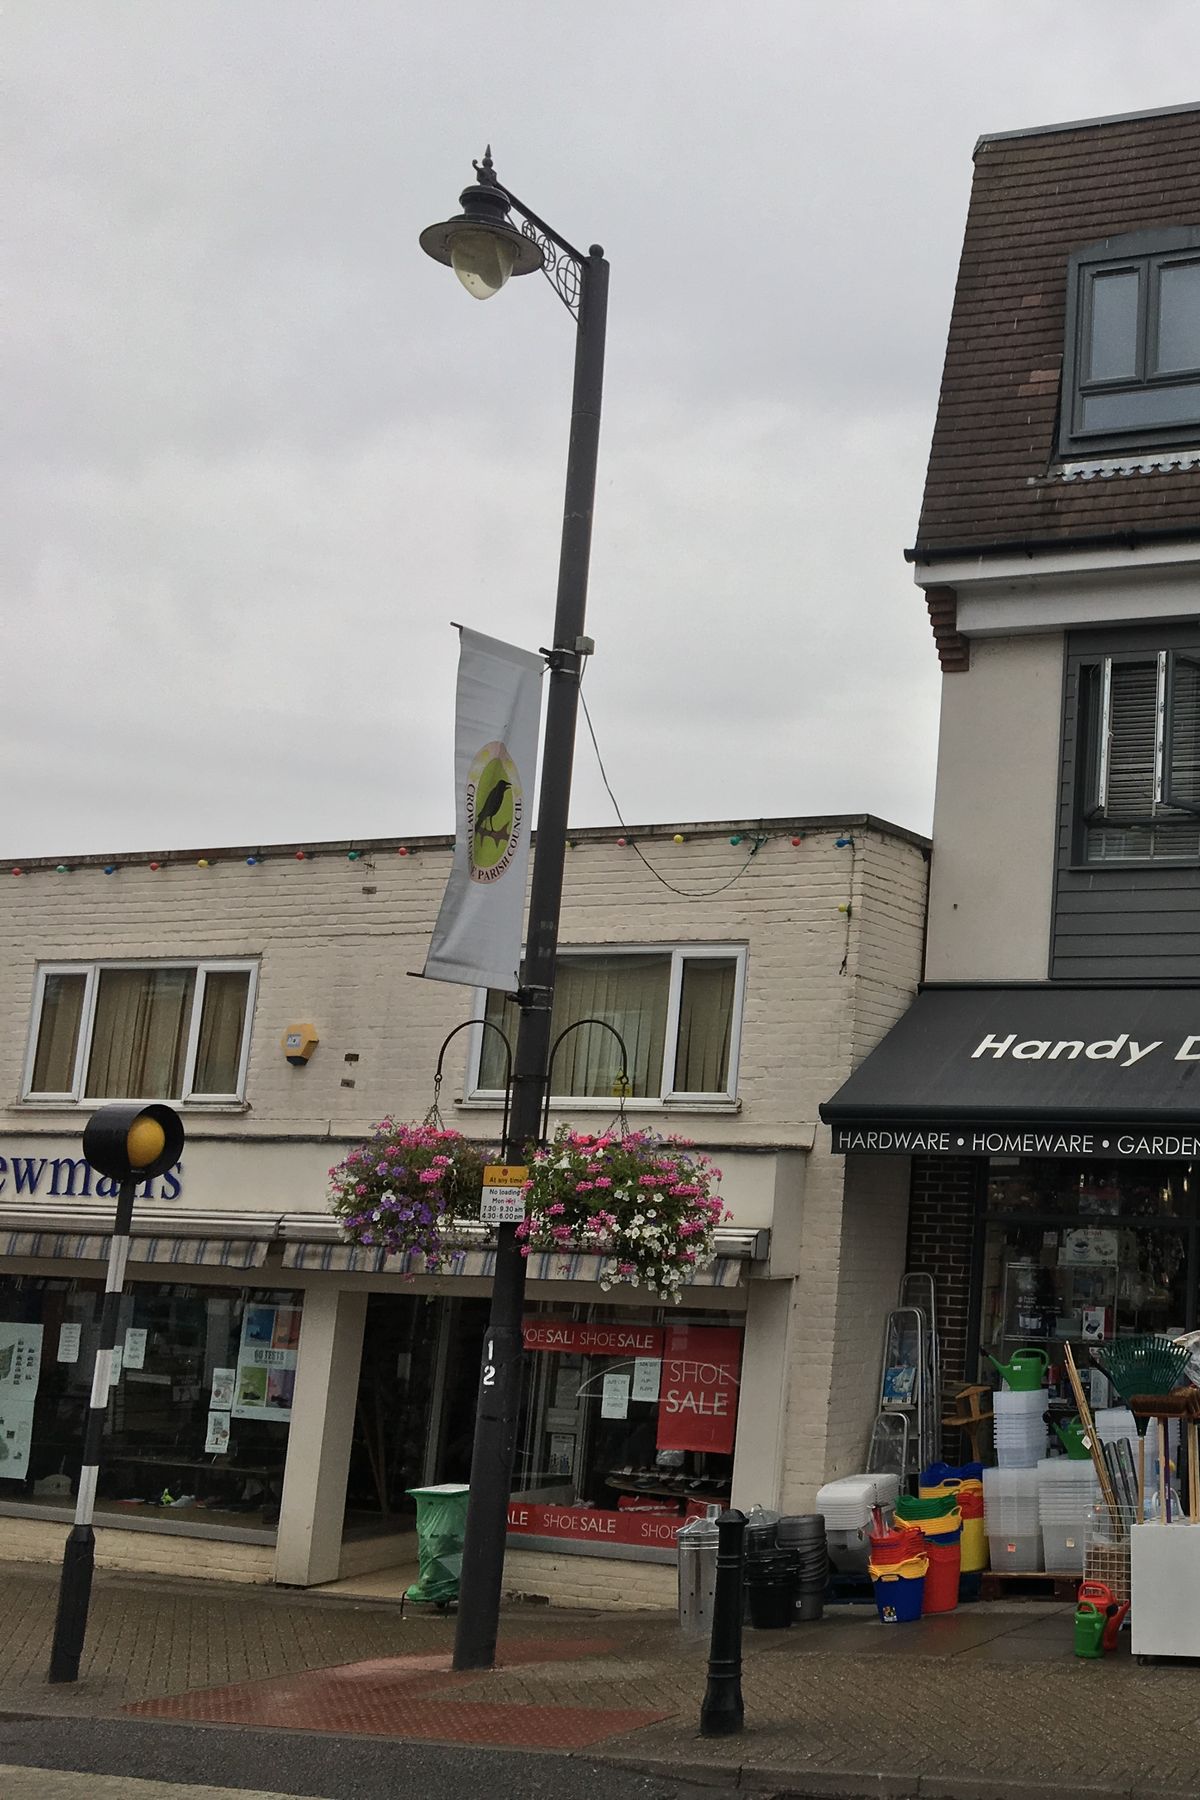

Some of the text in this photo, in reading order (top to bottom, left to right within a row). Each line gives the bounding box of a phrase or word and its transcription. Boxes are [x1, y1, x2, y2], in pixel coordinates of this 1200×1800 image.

[478, 856, 510, 881] PARISH
[971, 1033, 1163, 1067] Handy
[839, 1131, 950, 1150] HARDWARE
[972, 1133, 1094, 1153] HOMEWARE
[499, 1189, 520, 1197] loading
[669, 1361, 729, 1385] SHOE
[666, 1389, 728, 1416] SALE
